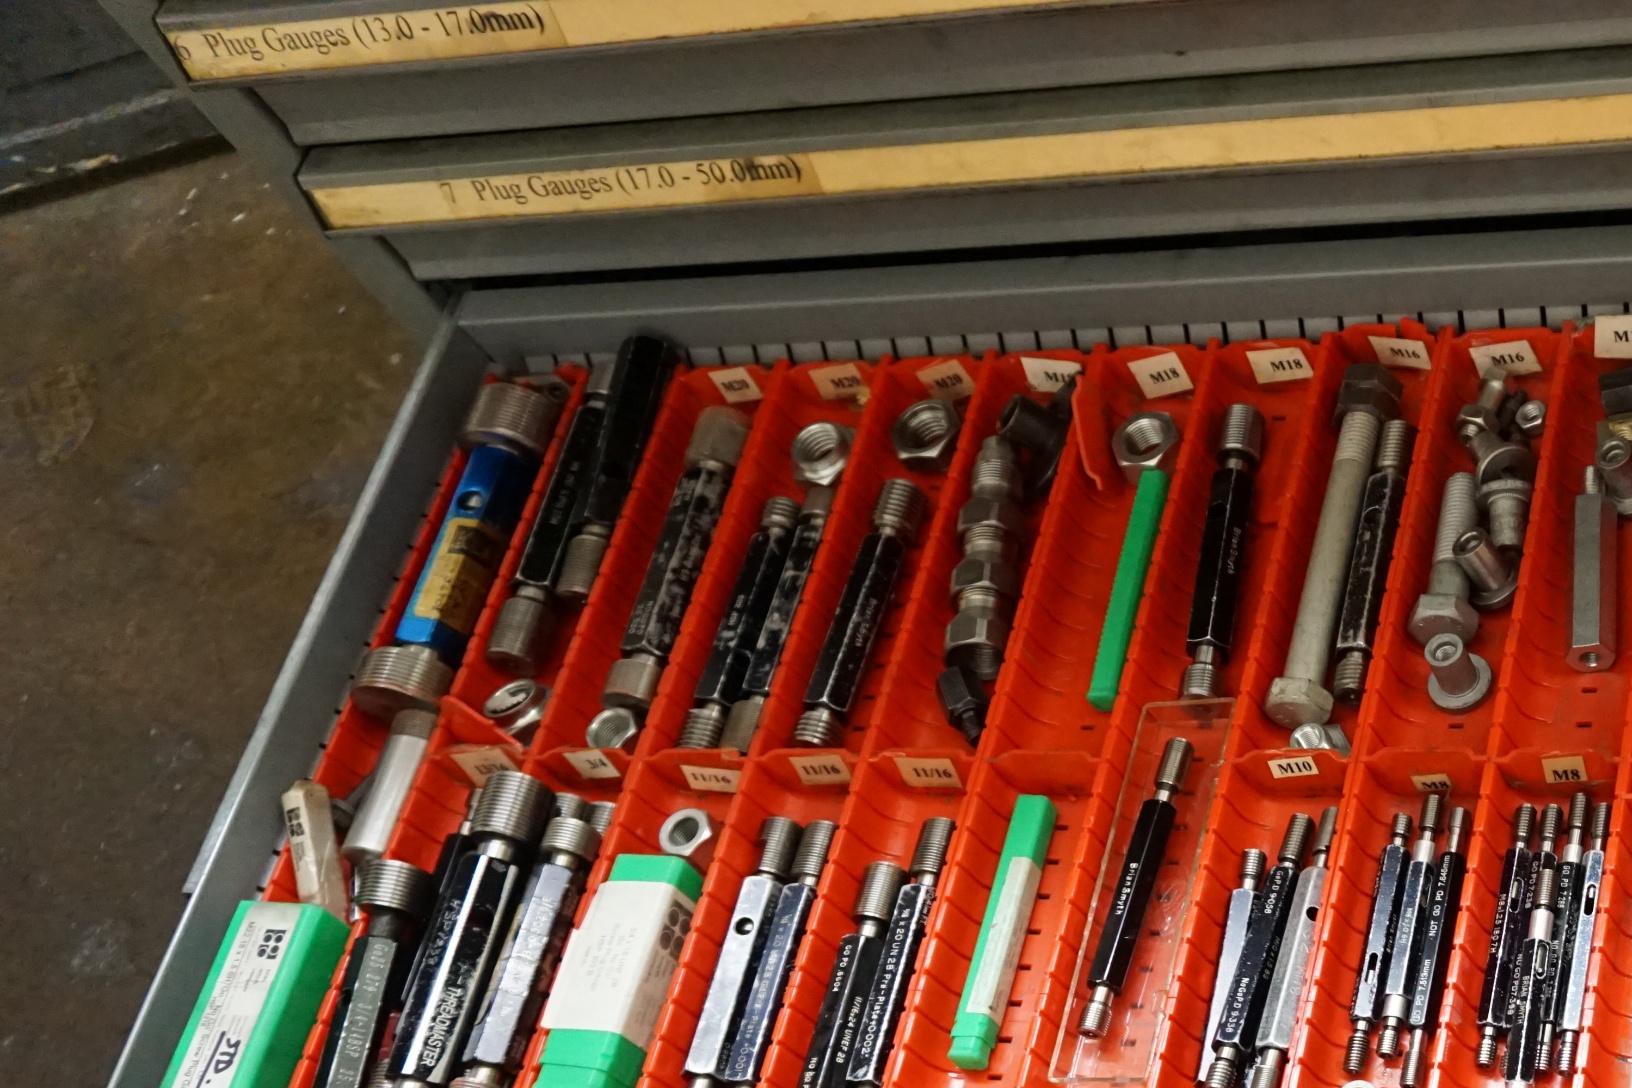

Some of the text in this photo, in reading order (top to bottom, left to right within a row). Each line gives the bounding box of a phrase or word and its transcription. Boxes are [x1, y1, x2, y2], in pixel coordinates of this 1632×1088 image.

[202, 30, 264, 61] Plug
[261, 24, 350, 55] Gauges
[471, 178, 529, 206] Plug
[528, 171, 612, 201] Gauges
[1389, 347, 1420, 360] M16
[1491, 352, 1524, 366] M16
[1270, 359, 1303, 372] M18
[1149, 367, 1180, 384] M18
[801, 764, 841, 776] 11/16
[913, 767, 952, 779] 11/16
[1277, 761, 1312, 774] M10
[691, 772, 731, 784] 11/16
[1552, 769, 1580, 781] M8
[1113, 861, 1138, 916] Brian Smyth
[1434, 888, 1445, 901] PD
[1431, 903, 1442, 917] GO
[1427, 919, 1439, 937] NOT
[842, 943, 852, 956] GO
[838, 955, 848, 968] PD
[1520, 975, 1529, 997] BRIAN
[1415, 993, 1425, 1006] PD
[1412, 1008, 1422, 1022] GO
[420, 984, 462, 1069] THREADMASTER
[838, 1028, 853, 1052] UNEF
[808, 1056, 818, 1070] NO
[834, 1051, 845, 1064] 2B
